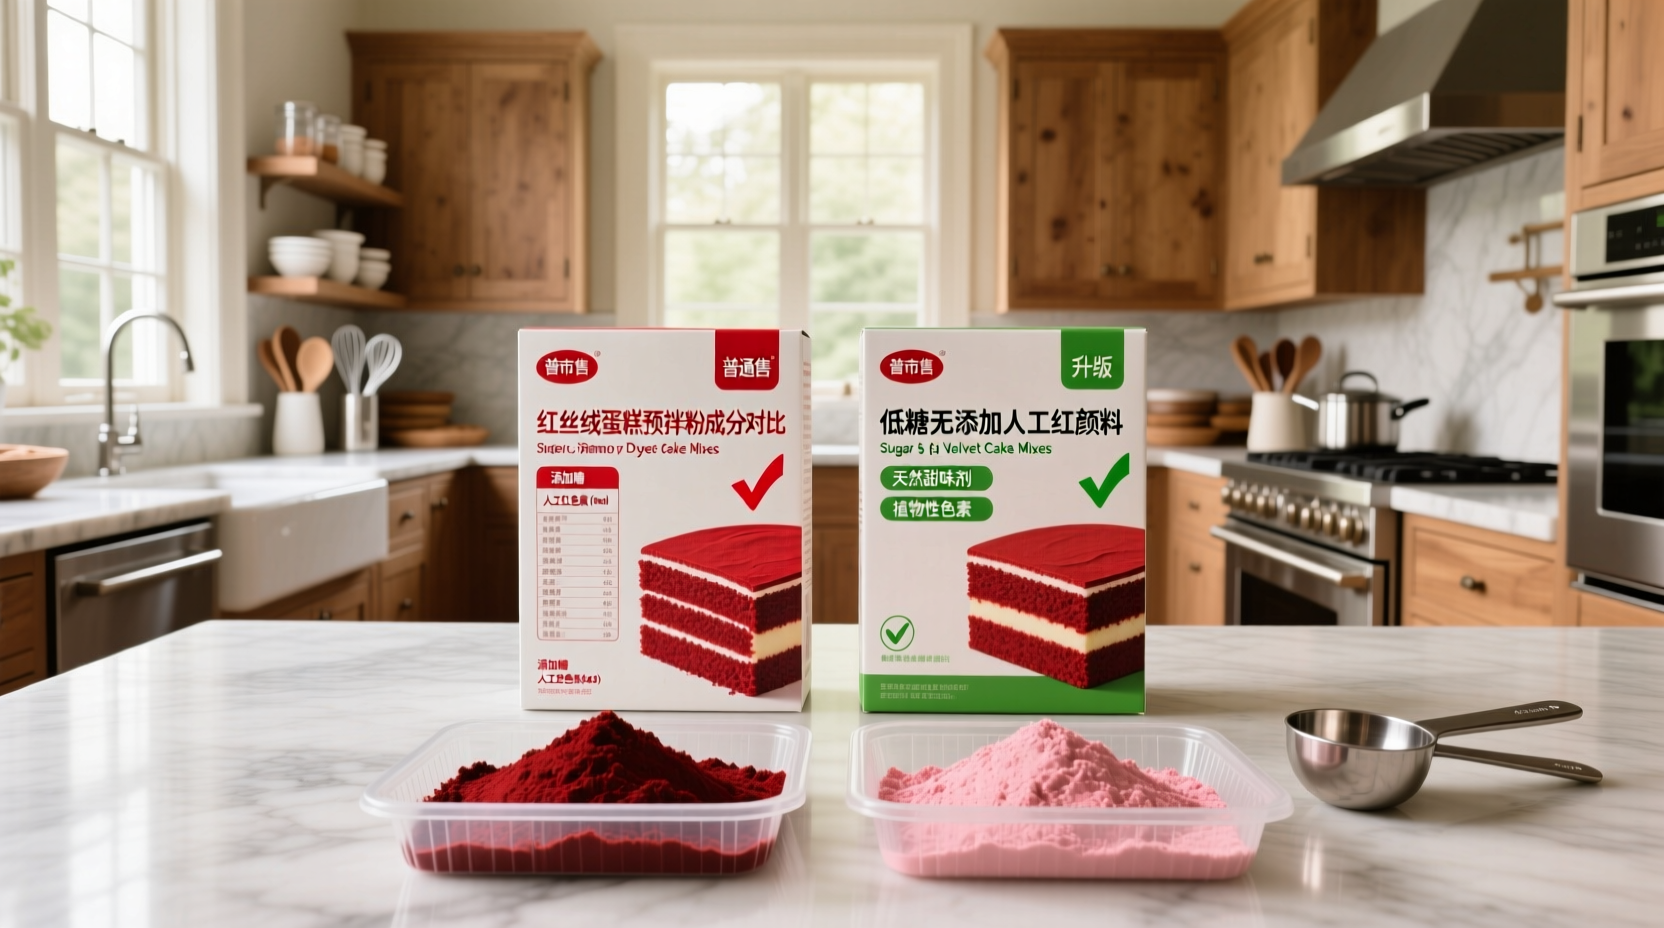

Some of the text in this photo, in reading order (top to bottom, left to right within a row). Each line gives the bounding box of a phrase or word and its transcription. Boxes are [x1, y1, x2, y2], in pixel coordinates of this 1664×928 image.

[1071, 355, 1113, 379] 升版
[879, 408, 1123, 436] 低糖无添加人工红颜料
[661, 442, 686, 455] Cake
[880, 442, 913, 457] Sugar
[943, 442, 981, 455] Velvet
[984, 442, 1014, 455] Cake
[1018, 442, 1052, 455] Mixes
[892, 469, 972, 488] 天然甜味剂
[893, 499, 972, 518] 植物性色素
